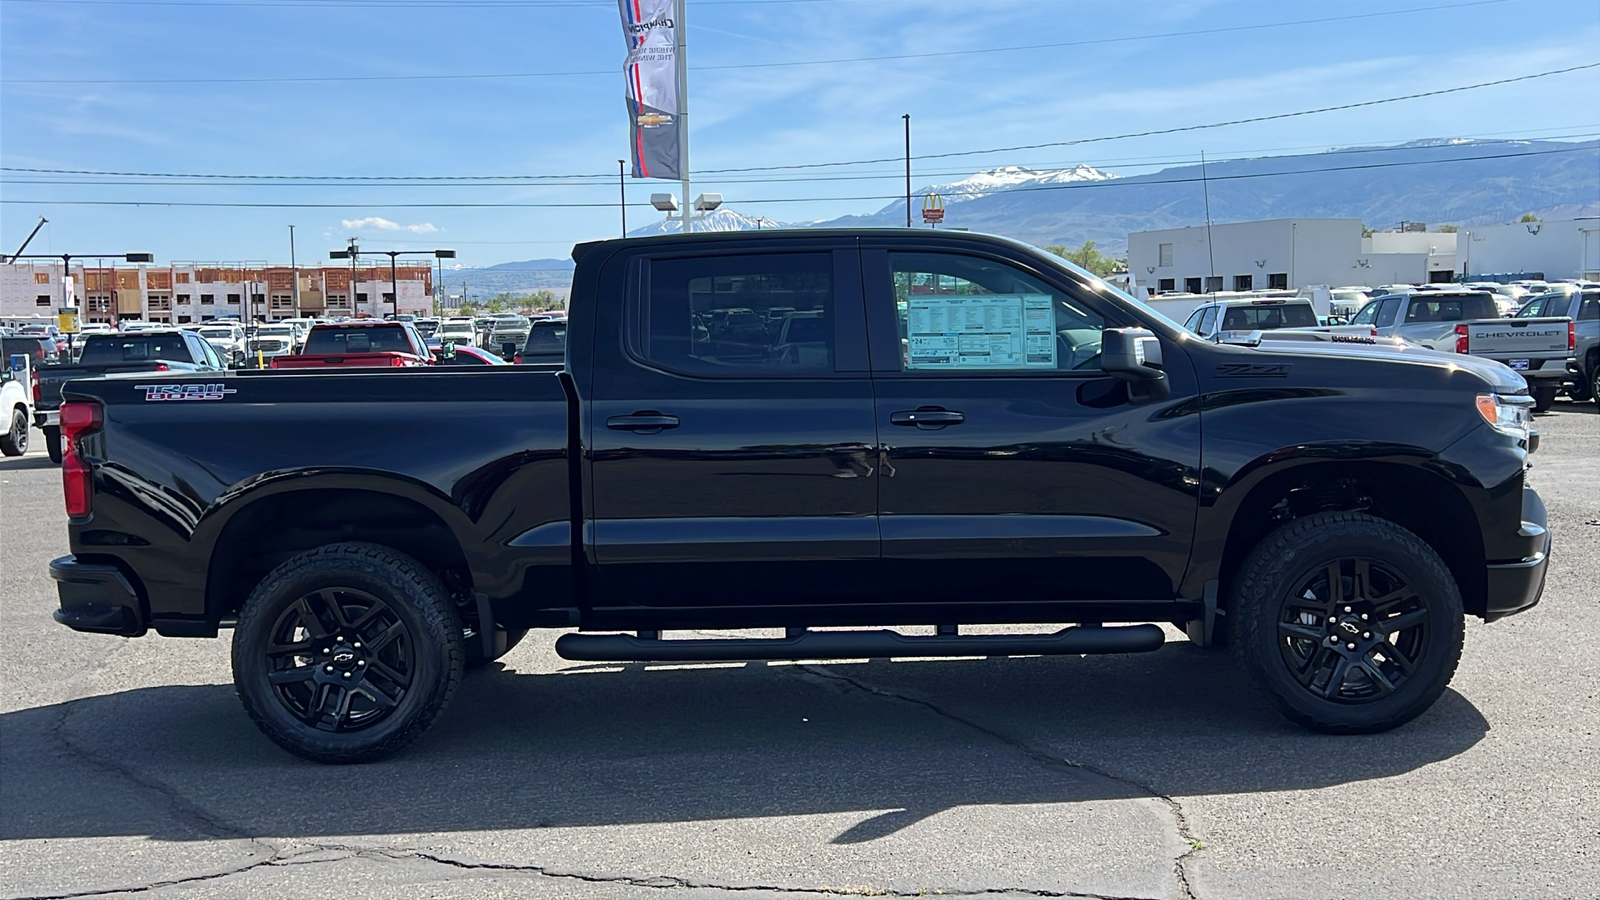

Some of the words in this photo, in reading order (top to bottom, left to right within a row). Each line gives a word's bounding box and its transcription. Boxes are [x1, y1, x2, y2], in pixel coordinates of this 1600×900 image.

[1475, 330, 1563, 339] CHEVROLET
[134, 384, 238, 394] TRAIL
[145, 392, 224, 401] BOSS
